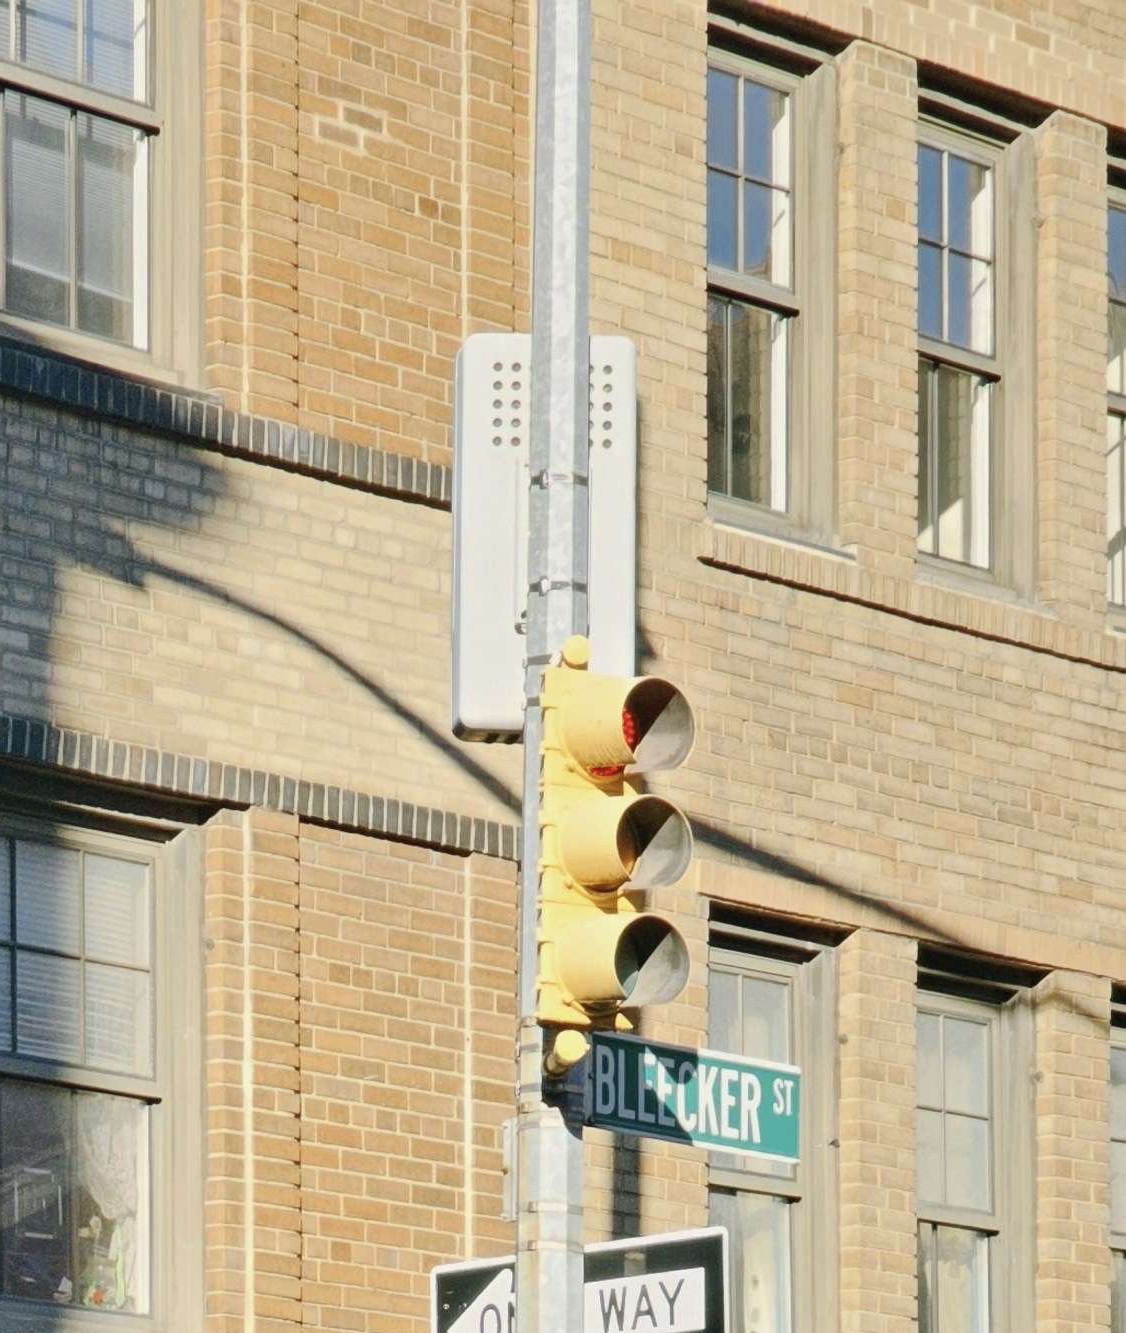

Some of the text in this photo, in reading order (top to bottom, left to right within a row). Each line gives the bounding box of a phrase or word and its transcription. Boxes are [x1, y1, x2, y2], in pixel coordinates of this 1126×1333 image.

[596, 1044, 794, 1144] BLEECKER ST
[599, 1278, 685, 1333] WAY
